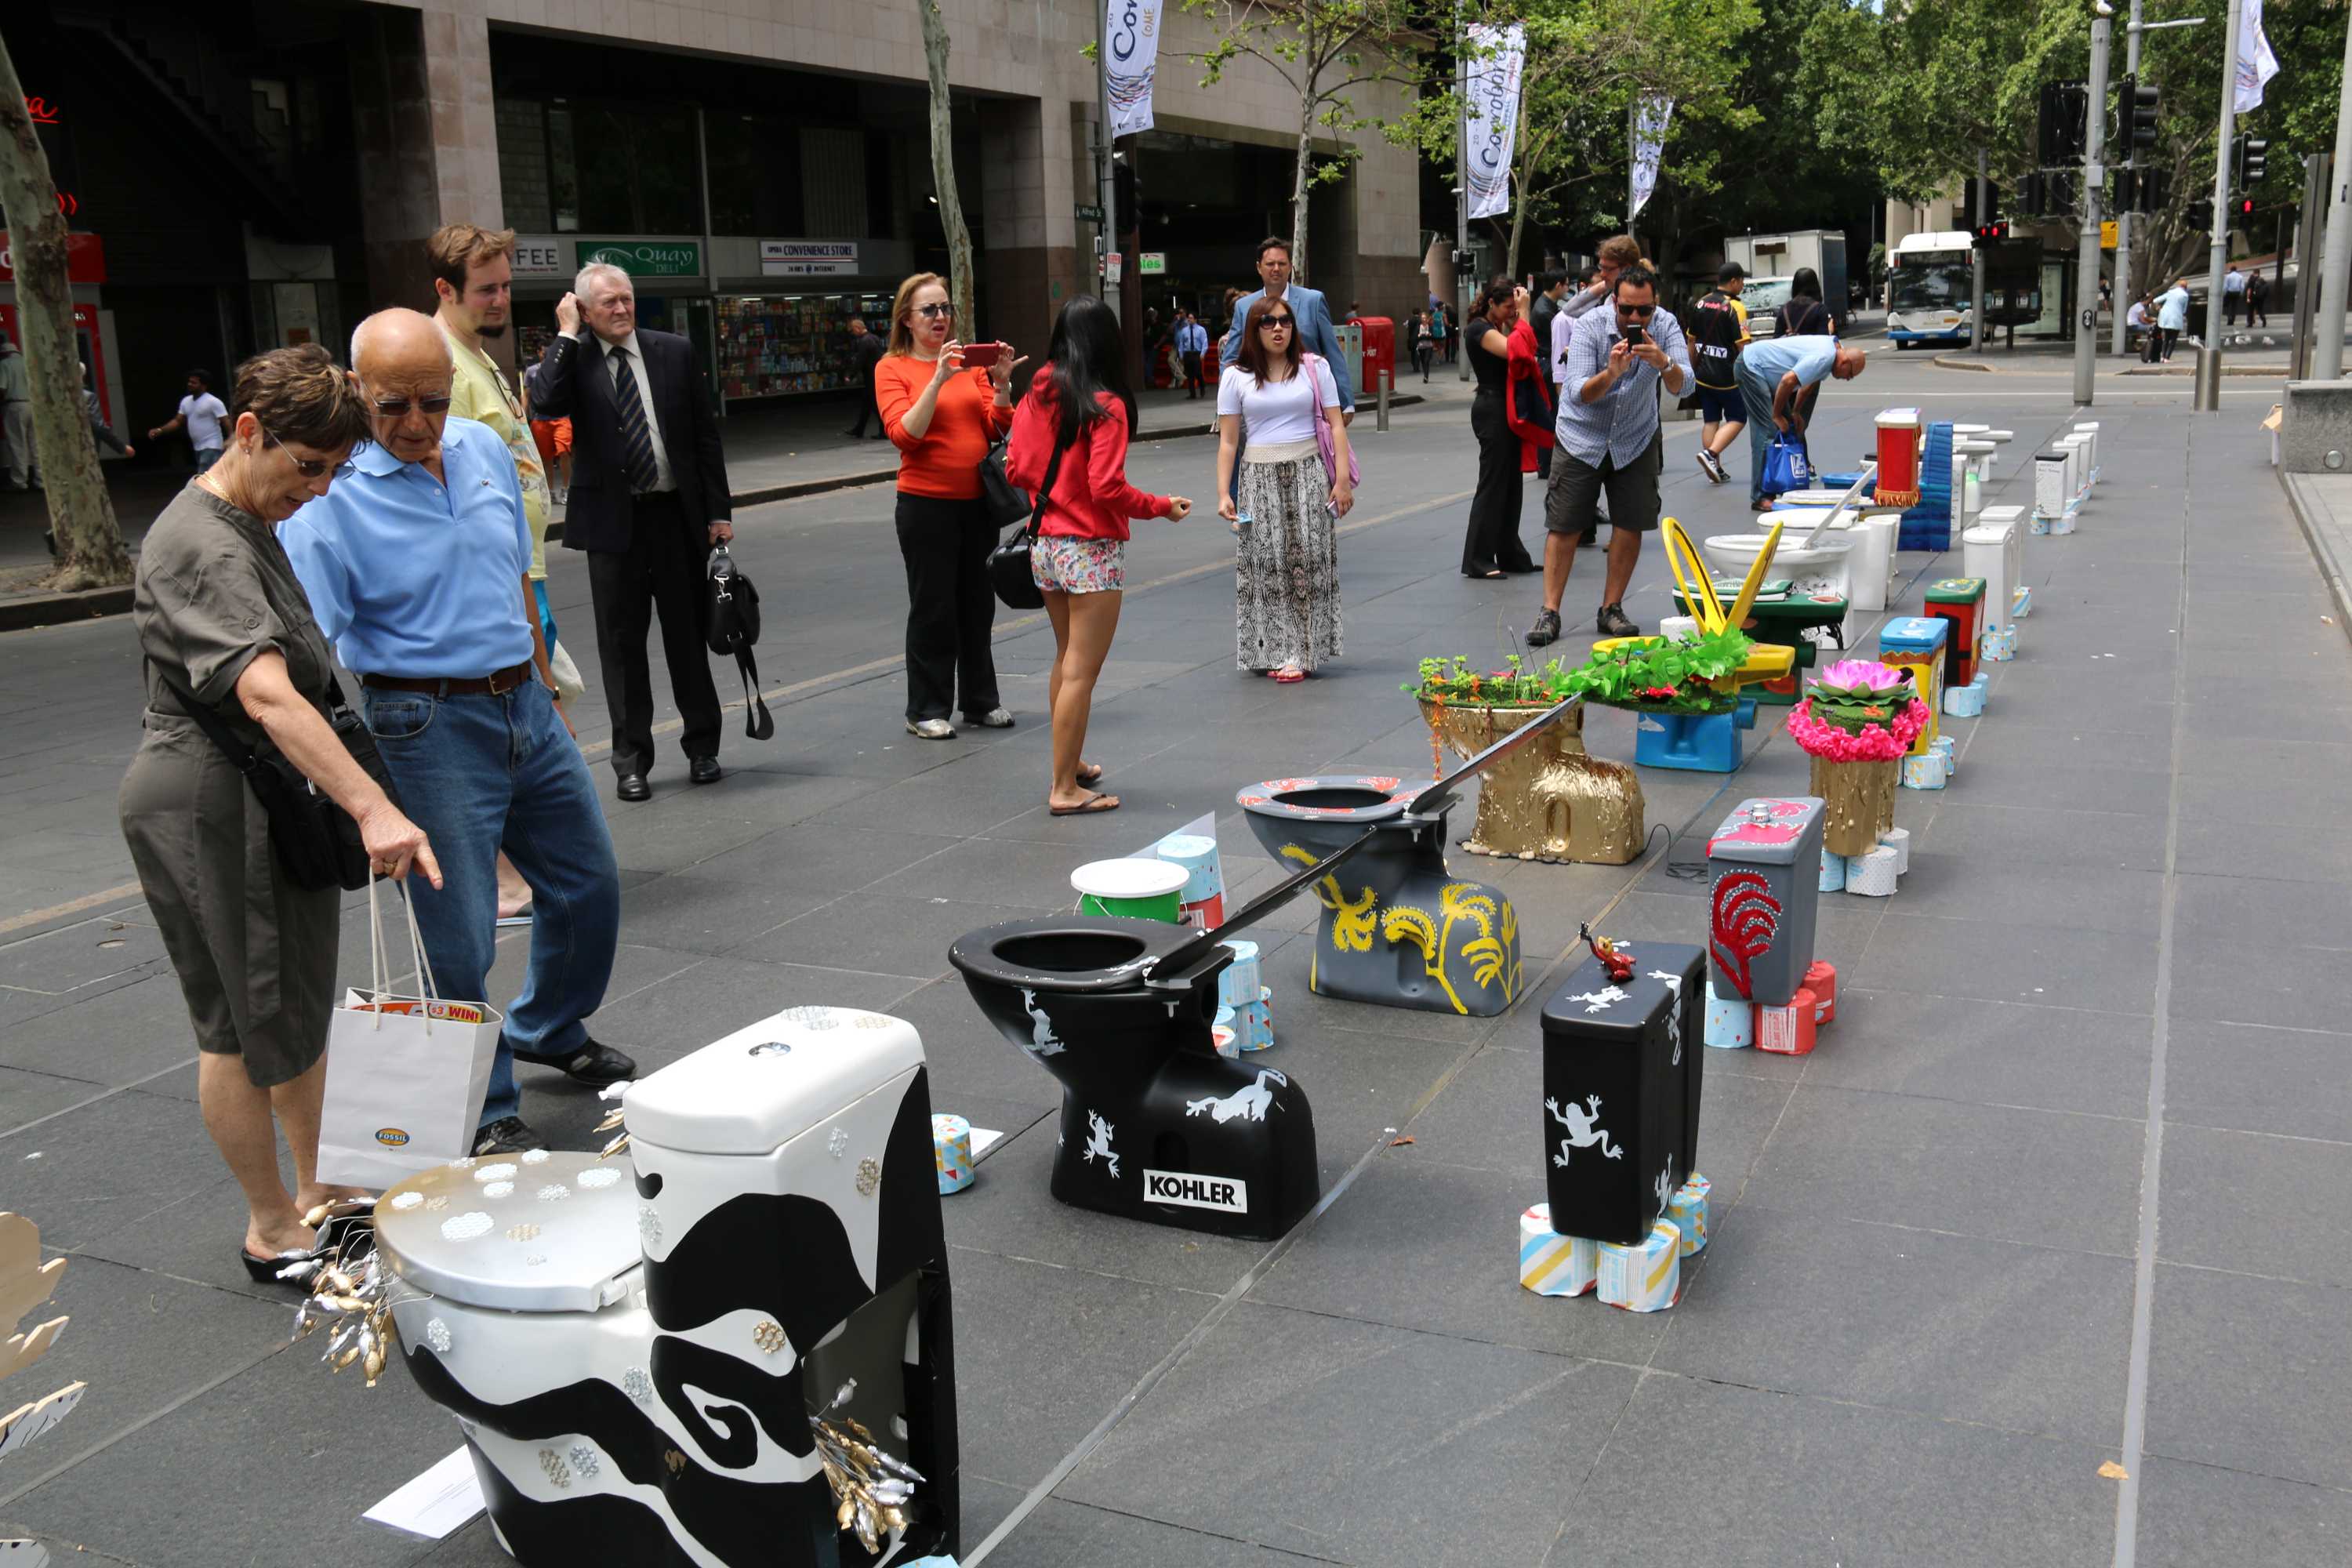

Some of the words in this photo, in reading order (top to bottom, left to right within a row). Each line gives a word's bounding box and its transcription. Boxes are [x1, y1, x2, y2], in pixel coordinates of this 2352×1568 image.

[516, 249, 558, 265] FEE
[636, 246, 693, 266] Quay
[784, 245, 830, 256] CONVENIENCE
[832, 245, 853, 256] STORE
[656, 264, 679, 273] DELI
[448, 1006, 478, 1022] WIN!
[379, 1133, 407, 1142] FOSSIL
[1149, 1175, 1236, 1206] KOHLER
